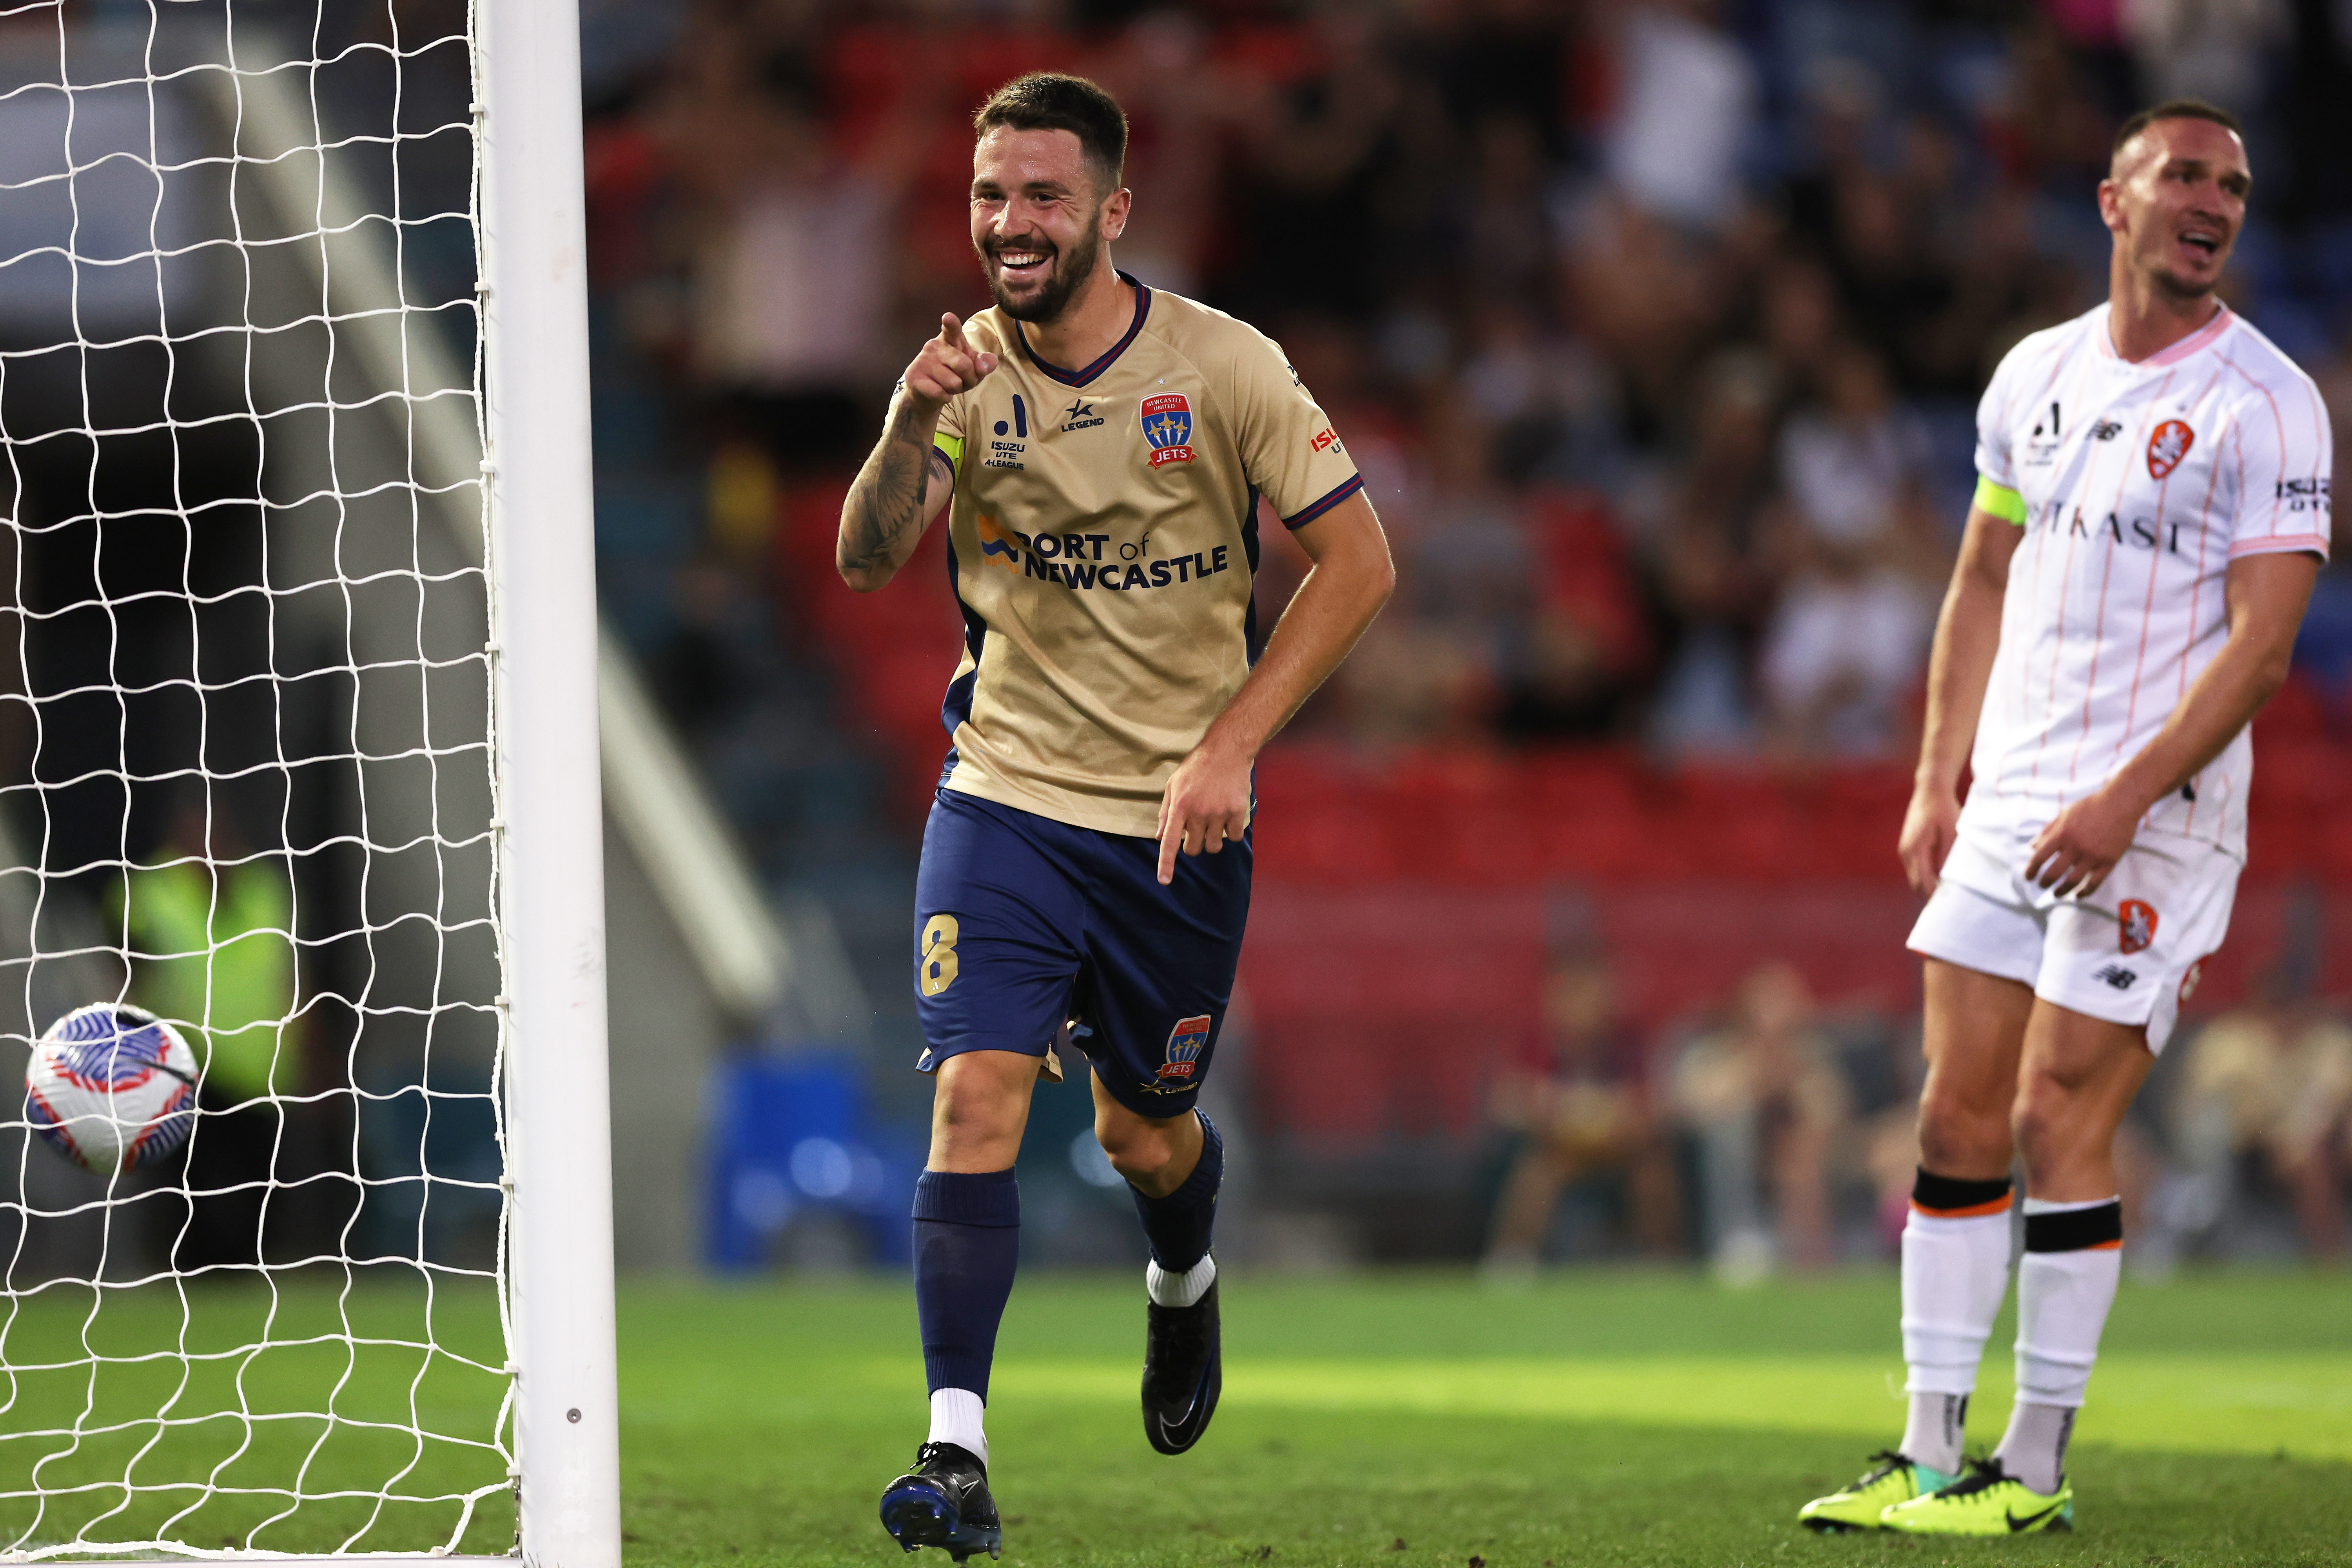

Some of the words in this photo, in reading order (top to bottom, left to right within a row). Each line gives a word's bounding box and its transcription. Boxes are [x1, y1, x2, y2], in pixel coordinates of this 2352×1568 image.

[1146, 398, 1182, 407] NEWCASTLE
[1061, 417, 1104, 432] LEGEND
[991, 441, 1025, 452] ISUZU
[1156, 449, 1187, 463] JETS
[985, 459, 1024, 470] A-LEAGUE
[1013, 531, 1110, 561] PORT
[1120, 532, 1149, 561] of
[1025, 545, 1228, 590] NEWCASTLE
[921, 914, 959, 997] 8
[1165, 1064, 1191, 1074] JETS
